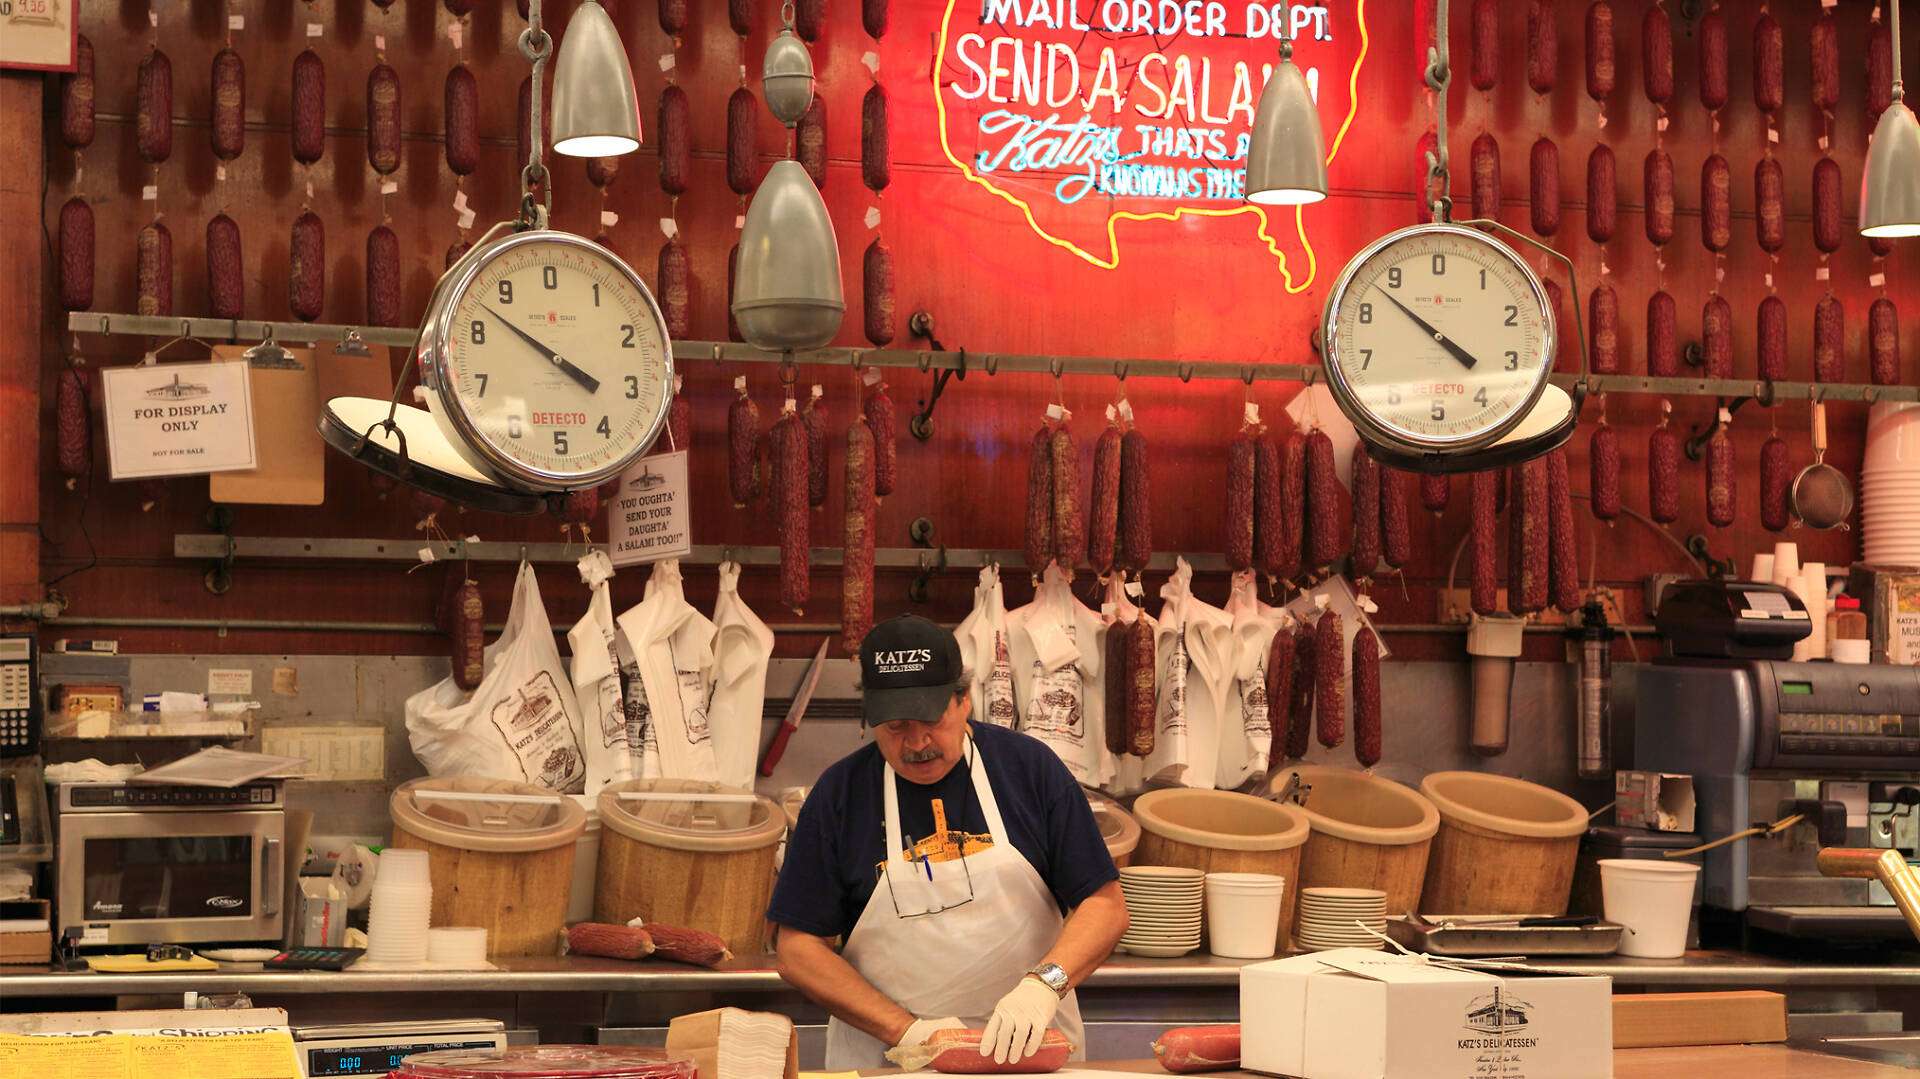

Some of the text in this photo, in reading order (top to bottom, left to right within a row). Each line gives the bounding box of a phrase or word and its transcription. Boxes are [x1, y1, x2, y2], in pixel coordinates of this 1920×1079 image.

[984, 0, 1332, 41] MAIL ORDER DEPT.
[951, 33, 1079, 107] SEND
[1082, 46, 1122, 112] A
[1432, 254, 1445, 275] 0
[543, 266, 557, 290] 0
[1388, 267, 1402, 288] 9
[1479, 269, 1486, 290] 1
[499, 280, 513, 304] 9
[592, 283, 600, 307] 1
[1359, 303, 1372, 324] 8
[1504, 305, 1518, 327] 2
[471, 321, 485, 344] 8
[621, 325, 635, 348] 2
[1359, 349, 1372, 371] 7
[1504, 351, 1518, 371] 3
[475, 374, 488, 398] 7
[624, 376, 639, 399] 3
[1412, 384, 1464, 395] DETECTO
[1473, 386, 1488, 407] 4
[134, 403, 228, 419] FOR DISPLAY
[532, 412, 586, 425] DETECTO
[1431, 400, 1445, 421] 5
[161, 421, 199, 432] ONLY
[508, 415, 522, 439] 6
[596, 416, 611, 439] 4
[554, 431, 568, 455] 5
[626, 507, 672, 523] SEND YOUR
[618, 543, 623, 552] A
[625, 537, 654, 551] SALAMI
[874, 649, 931, 665] KATZ'S
[879, 664, 925, 673] DELICATESSEN
[1458, 1039, 1481, 1048] KATZ'S
